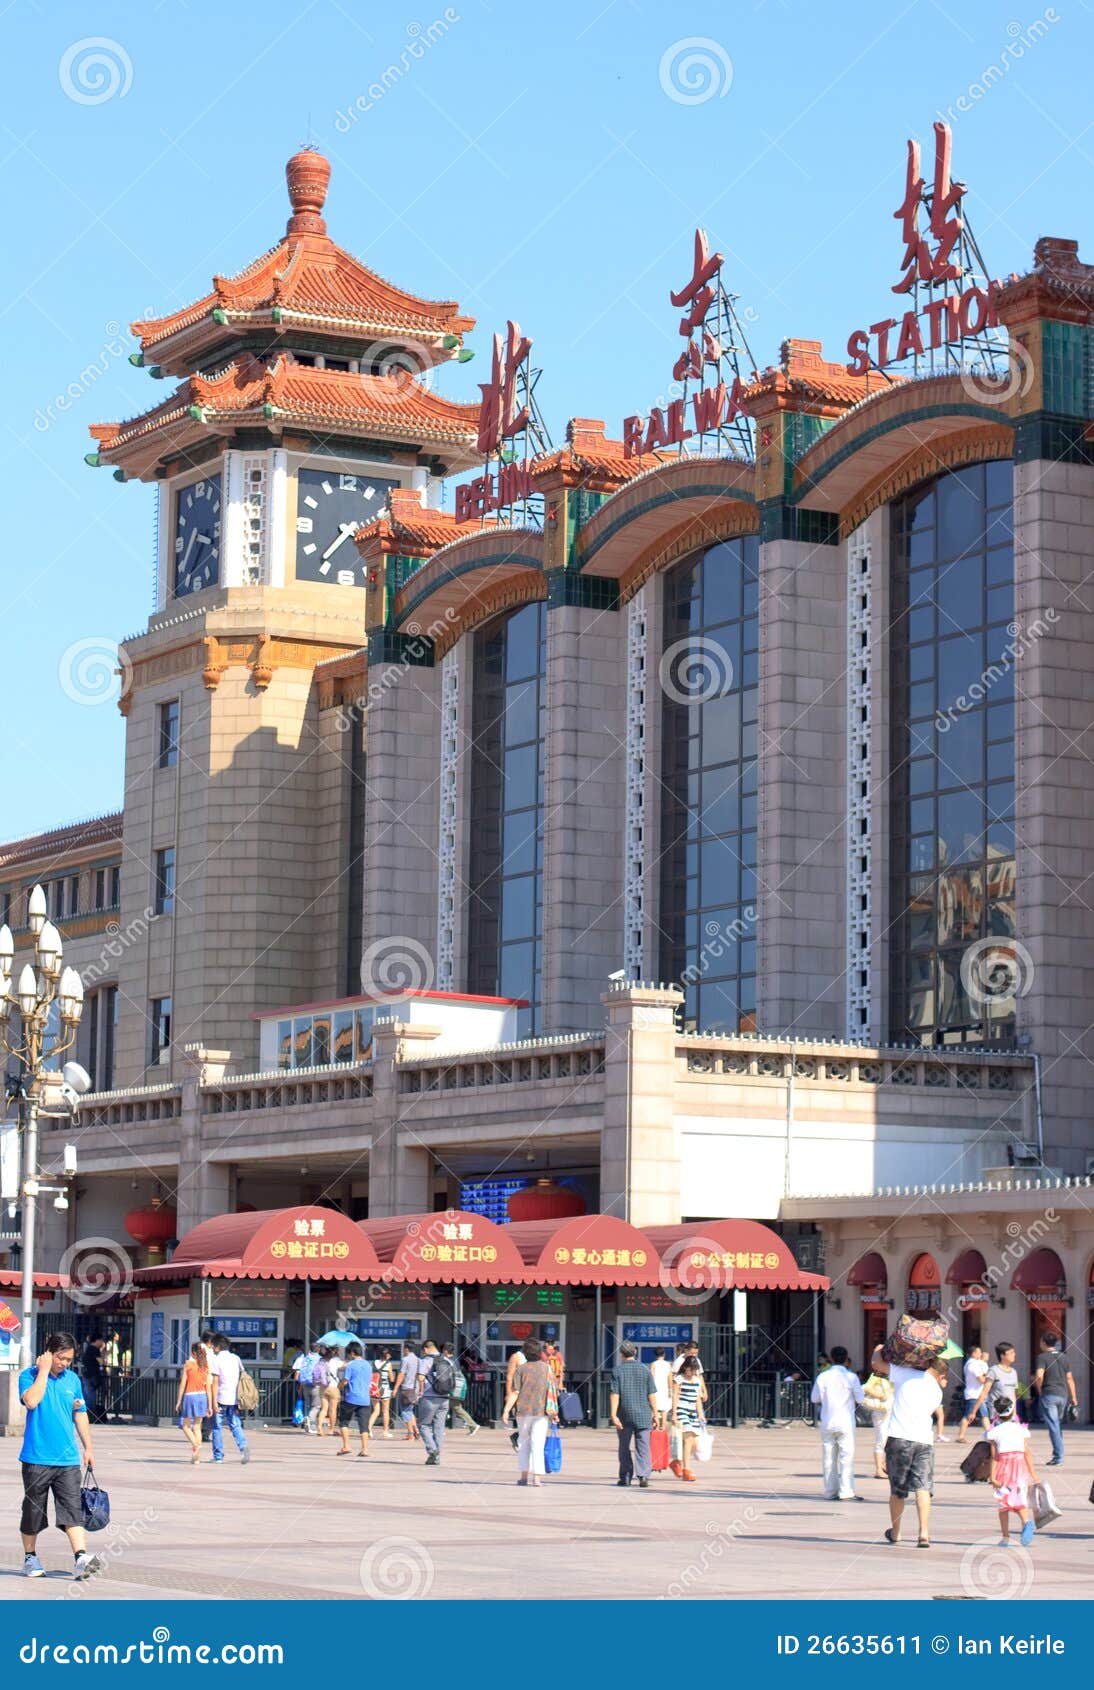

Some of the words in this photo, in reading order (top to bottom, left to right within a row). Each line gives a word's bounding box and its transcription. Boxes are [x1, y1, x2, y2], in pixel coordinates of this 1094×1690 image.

[455, 457, 536, 524] BEIJIN
[623, 368, 762, 460] RAILWA
[339, 475, 357, 492] 12
[294, 1219, 325, 1237] 验票
[443, 1223, 473, 1241] 验票
